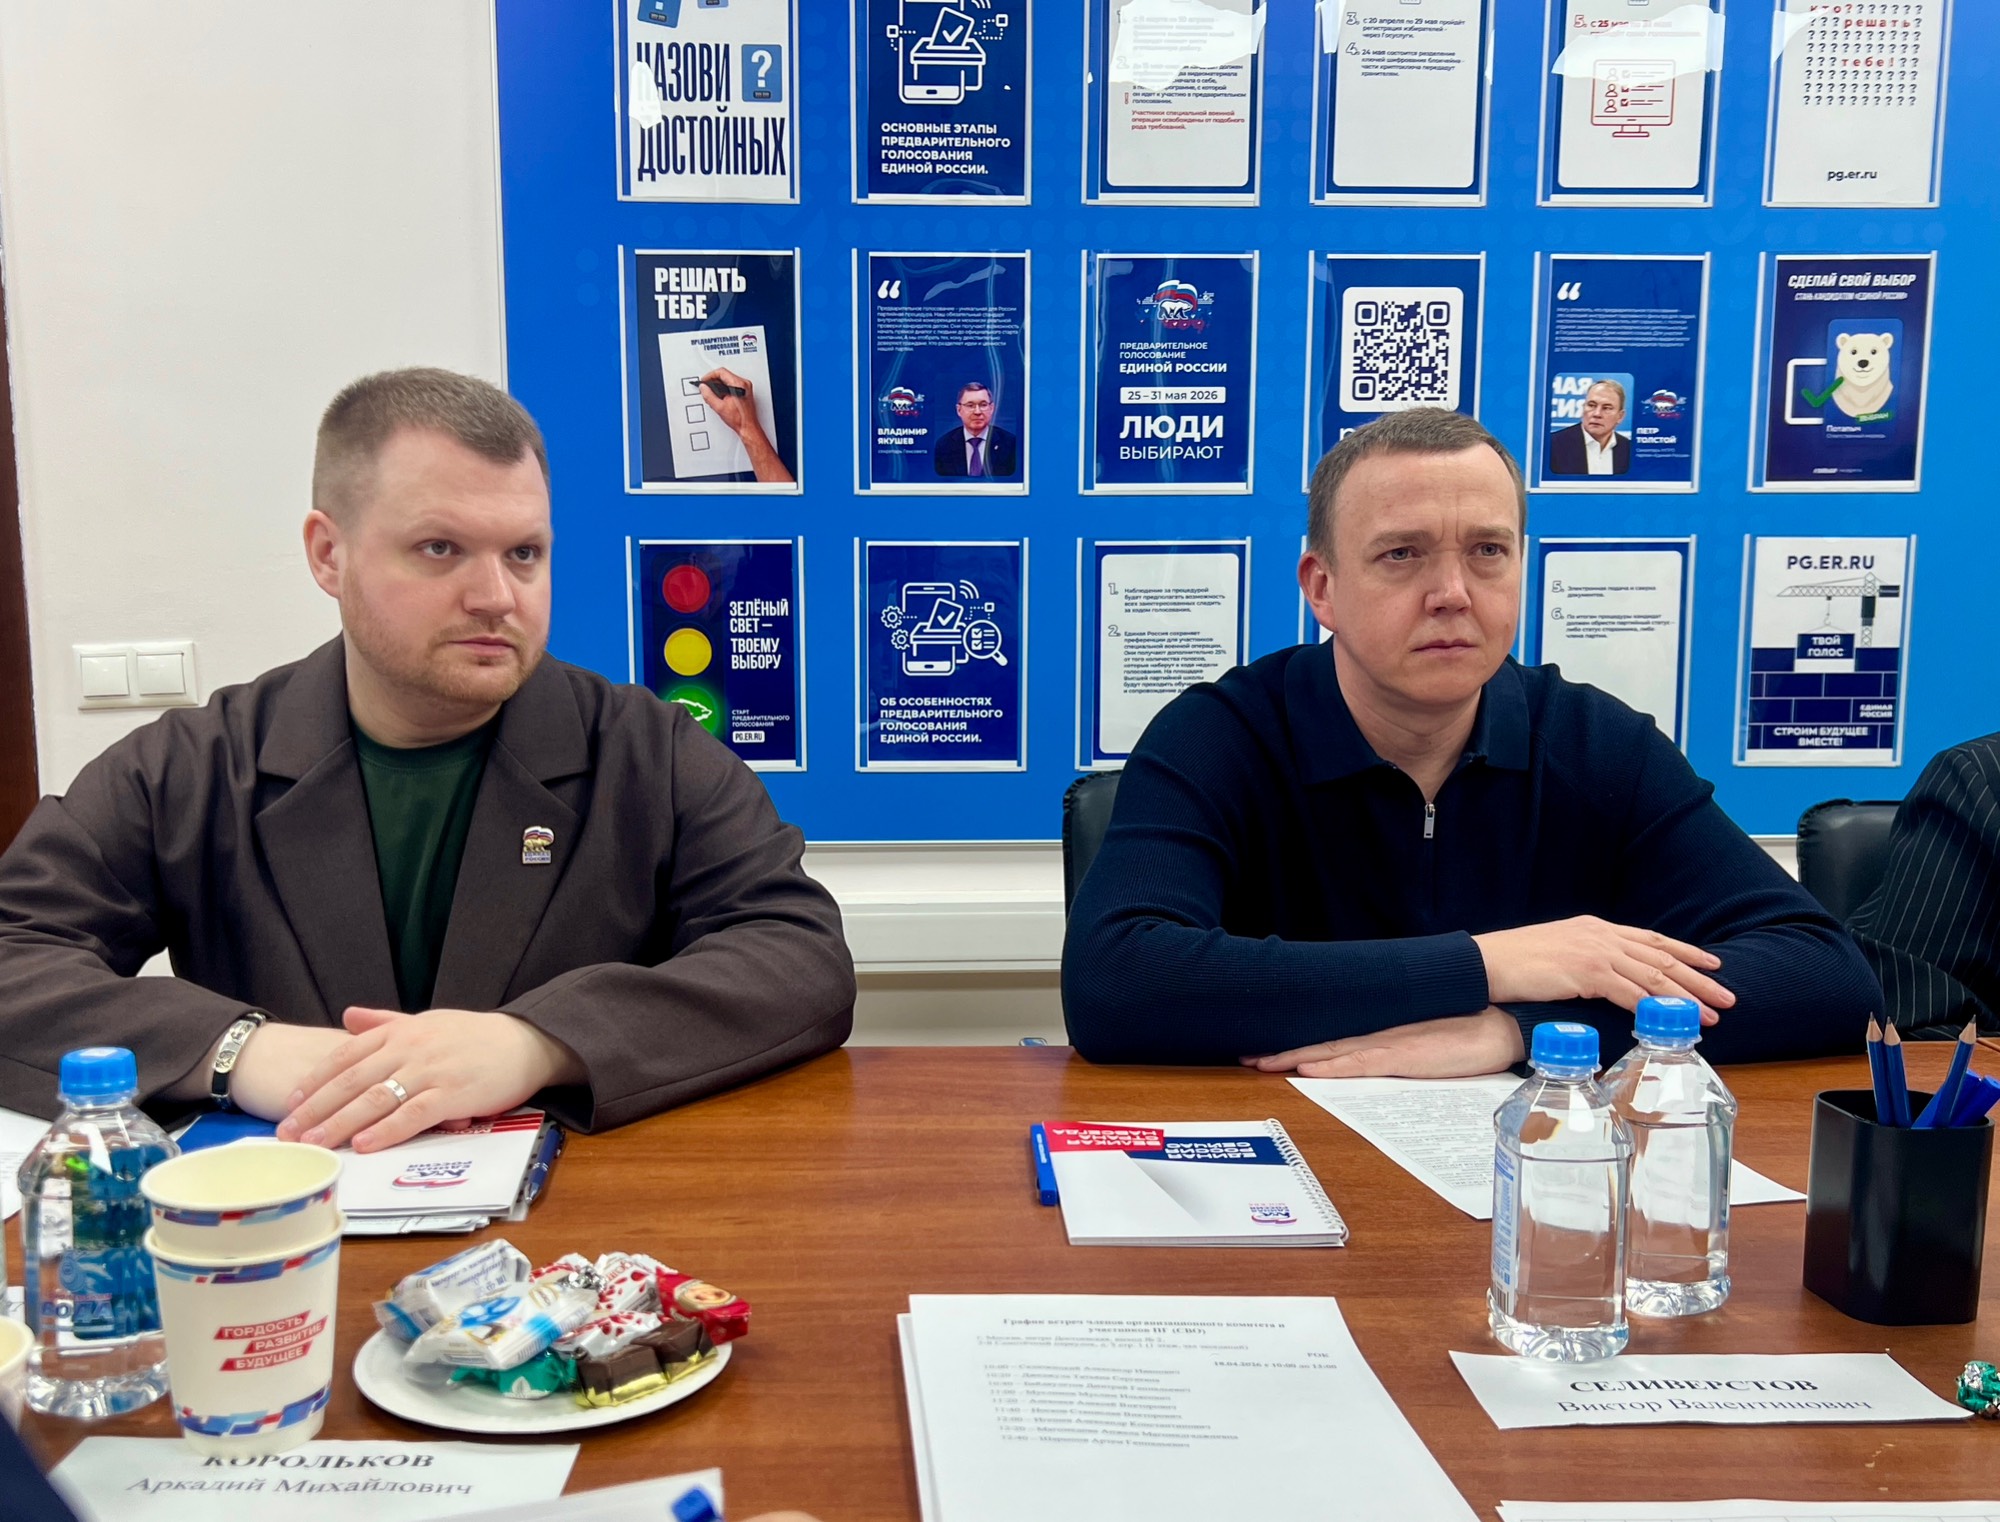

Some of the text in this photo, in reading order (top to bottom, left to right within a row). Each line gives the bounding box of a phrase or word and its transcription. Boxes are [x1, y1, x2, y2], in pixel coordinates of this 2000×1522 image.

[881, 123, 998, 135] ОСНОВНЫЕ ЭТАПЫ
[637, 105, 787, 182] ДОСТОЙНЫХ
[881, 136, 1011, 149] ПРЕДВАРИТЕЛЬНОГО
[881, 150, 973, 161] ГОЛОСОВАНИЯ
[881, 162, 989, 176] ЕДИНОЙ РОССИИ.
[1828, 170, 1878, 181] pg.er.ru
[654, 267, 747, 293] РЕШАТЬ
[1788, 272, 1916, 288] СДЕЛАЙ СВОЙ ВЫБОР
[654, 295, 708, 320] ТЕБЕ
[1120, 342, 1208, 350] ПРЕДВАРИТЕЛЬНОЕ
[1119, 362, 1227, 374] ЕДИНОЙ РОССИИ
[1128, 391, 1141, 400] 25
[1150, 391, 1162, 400] 31
[1190, 390, 1218, 400] 2026
[878, 428, 928, 436] ВЛАДИМИР
[1119, 415, 1224, 442] ЛЮДИ
[1636, 436, 1677, 444] ТОЛСТОЙ
[1120, 446, 1224, 459] ВЫБИРАЮТ
[1787, 556, 1876, 570] PG.ER.RU
[730, 598, 788, 616] ЗЕЛЁНЫЙ
[730, 618, 760, 633] СВЕТ
[730, 638, 780, 653] ТВОЕМУ
[1812, 635, 1841, 645] ТВОЙ
[1808, 648, 1844, 656] ГОЛОС
[732, 654, 782, 670] ВЫБОРУ
[880, 698, 992, 706] ОБ ОСОБЕННОСТЯХ
[880, 710, 1003, 720] ПРЕДВАРИТЕЛЬНОГО
[880, 722, 967, 730] ГОЛОСОВАНИЯ
[1773, 727, 1869, 737] СТРОИМ БУДУЩЕЕ
[735, 732, 763, 741] PG.ER.RU
[880, 732, 982, 744] ЕДИНОЙ РОССИИ.
[1798, 738, 1843, 746] ВМЕСТЕ!
[223, 1316, 303, 1338] ГОРДОСТЬ
[254, 1322, 322, 1350] РАЗВИТИЕ
[236, 1347, 304, 1369] БУДУЩЕЕ
[1570, 1379, 1818, 1393] СЕЛИВЕРСТОВ
[1557, 1398, 1872, 1414] Виктор Валентинович
[126, 1478, 474, 1495] Аркадий Михайлович
